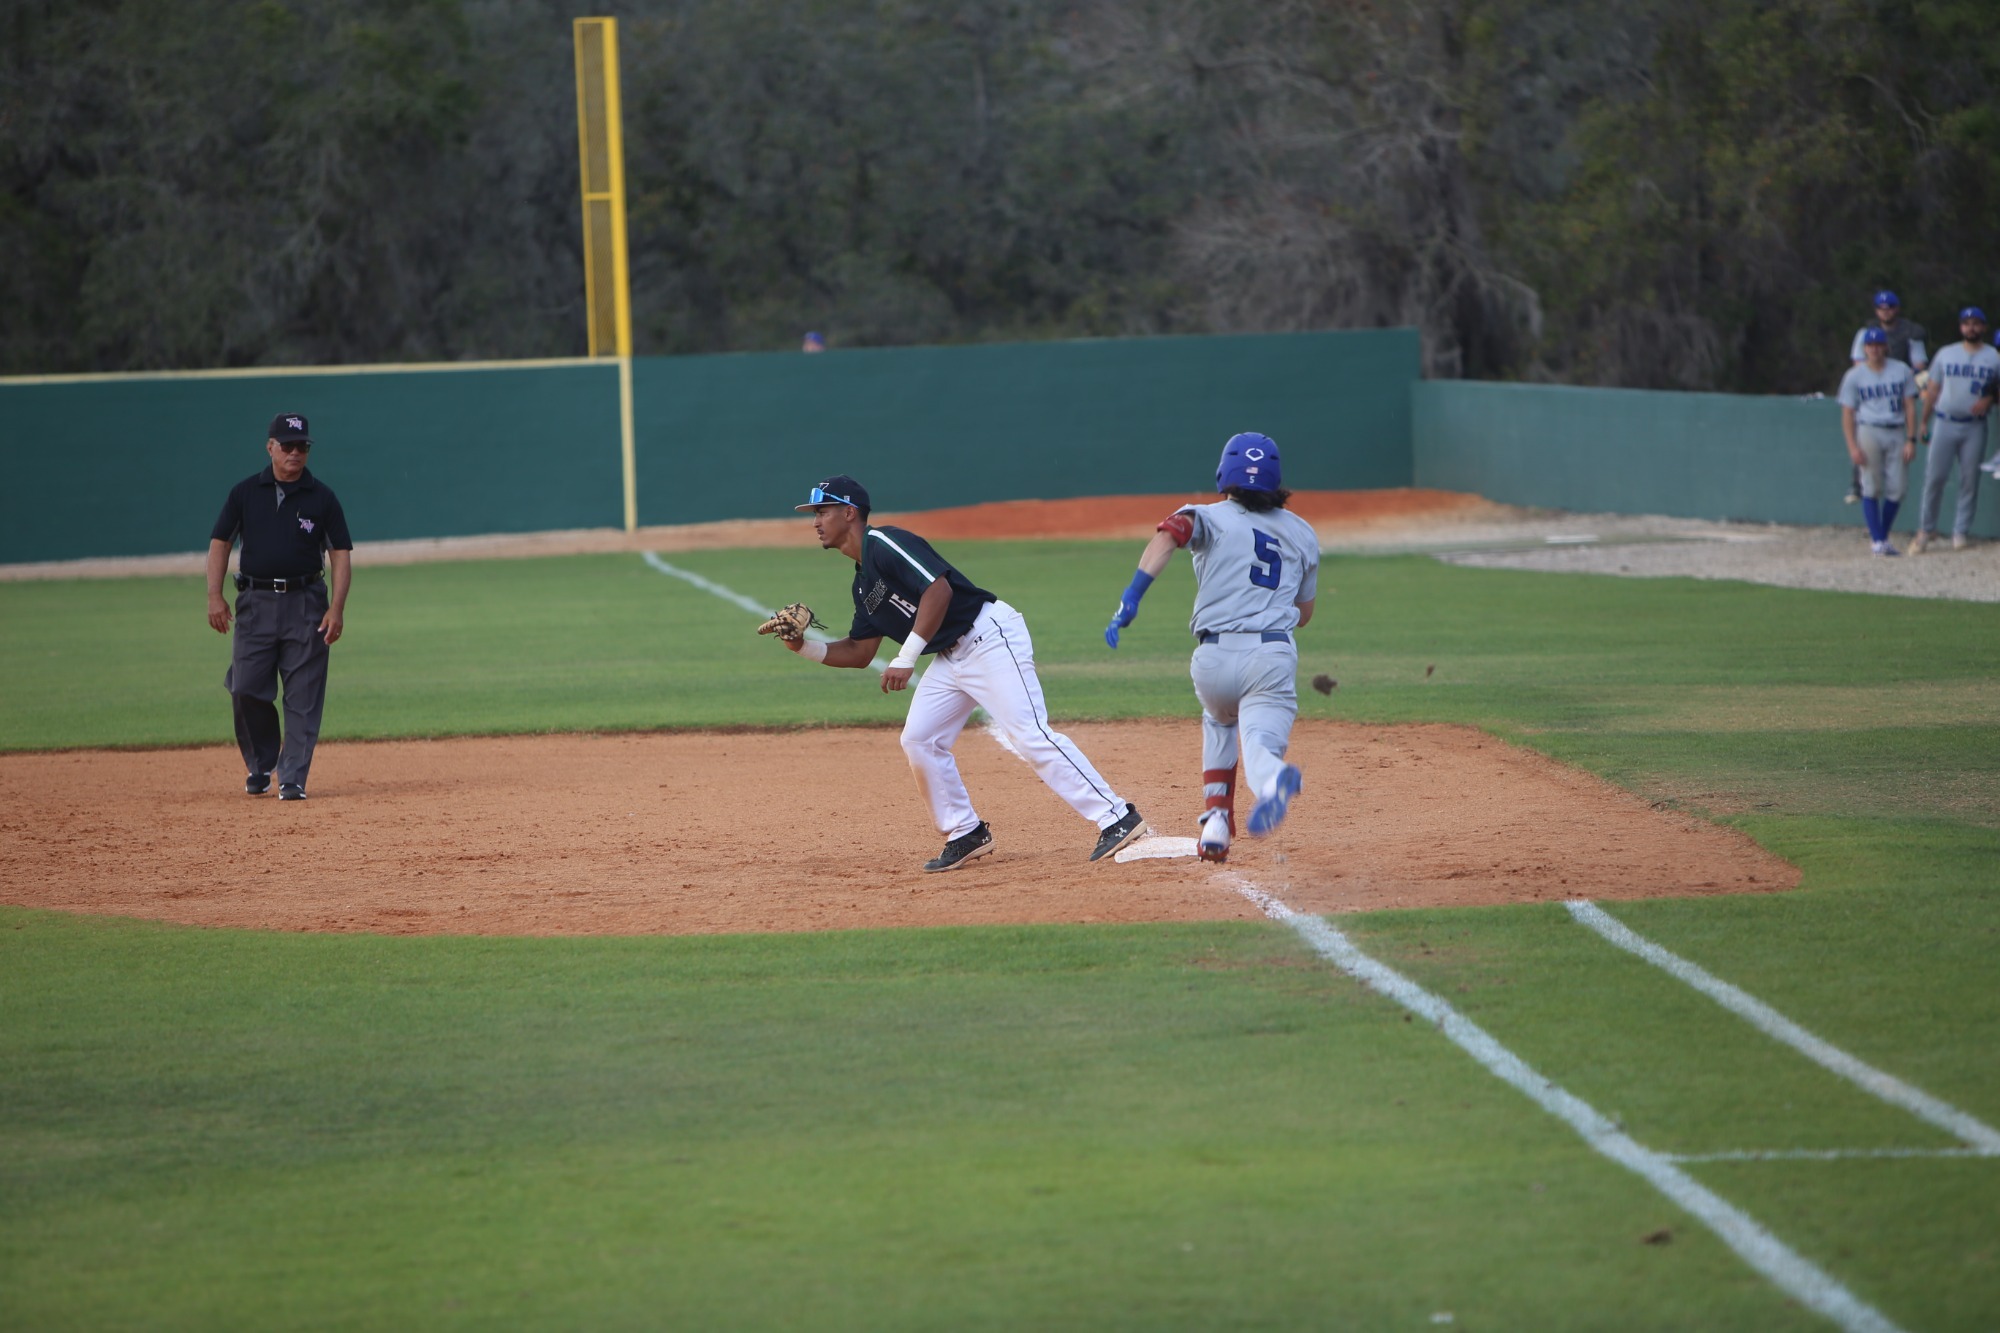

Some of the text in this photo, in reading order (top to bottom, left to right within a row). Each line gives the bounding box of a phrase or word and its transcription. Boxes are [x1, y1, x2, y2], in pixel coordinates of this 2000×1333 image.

[1249, 475, 1255, 484] 5
[1249, 528, 1282, 590] 5
[888, 593, 917, 618] 16
